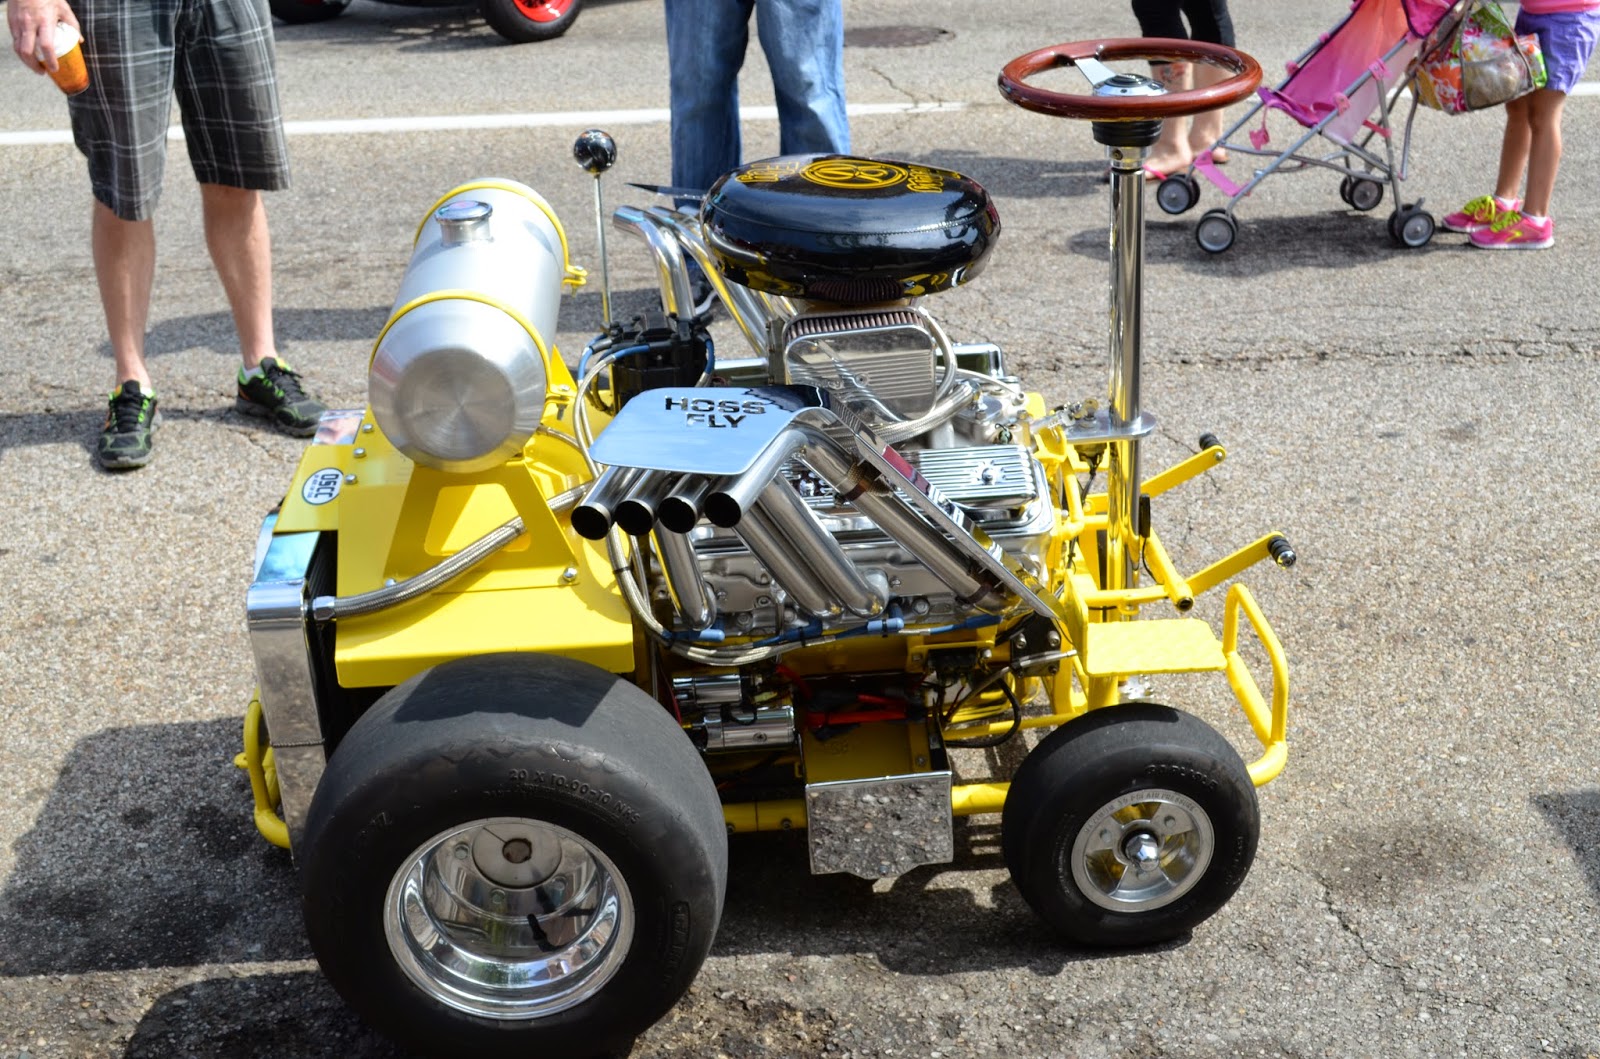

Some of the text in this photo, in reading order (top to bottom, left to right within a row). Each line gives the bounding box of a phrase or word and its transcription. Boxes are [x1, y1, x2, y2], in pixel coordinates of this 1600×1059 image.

[665, 396, 766, 414] HOSS
[686, 413, 746, 428] FLY
[508, 768, 528, 781] 20
[551, 773, 612, 804] 10.00-10
